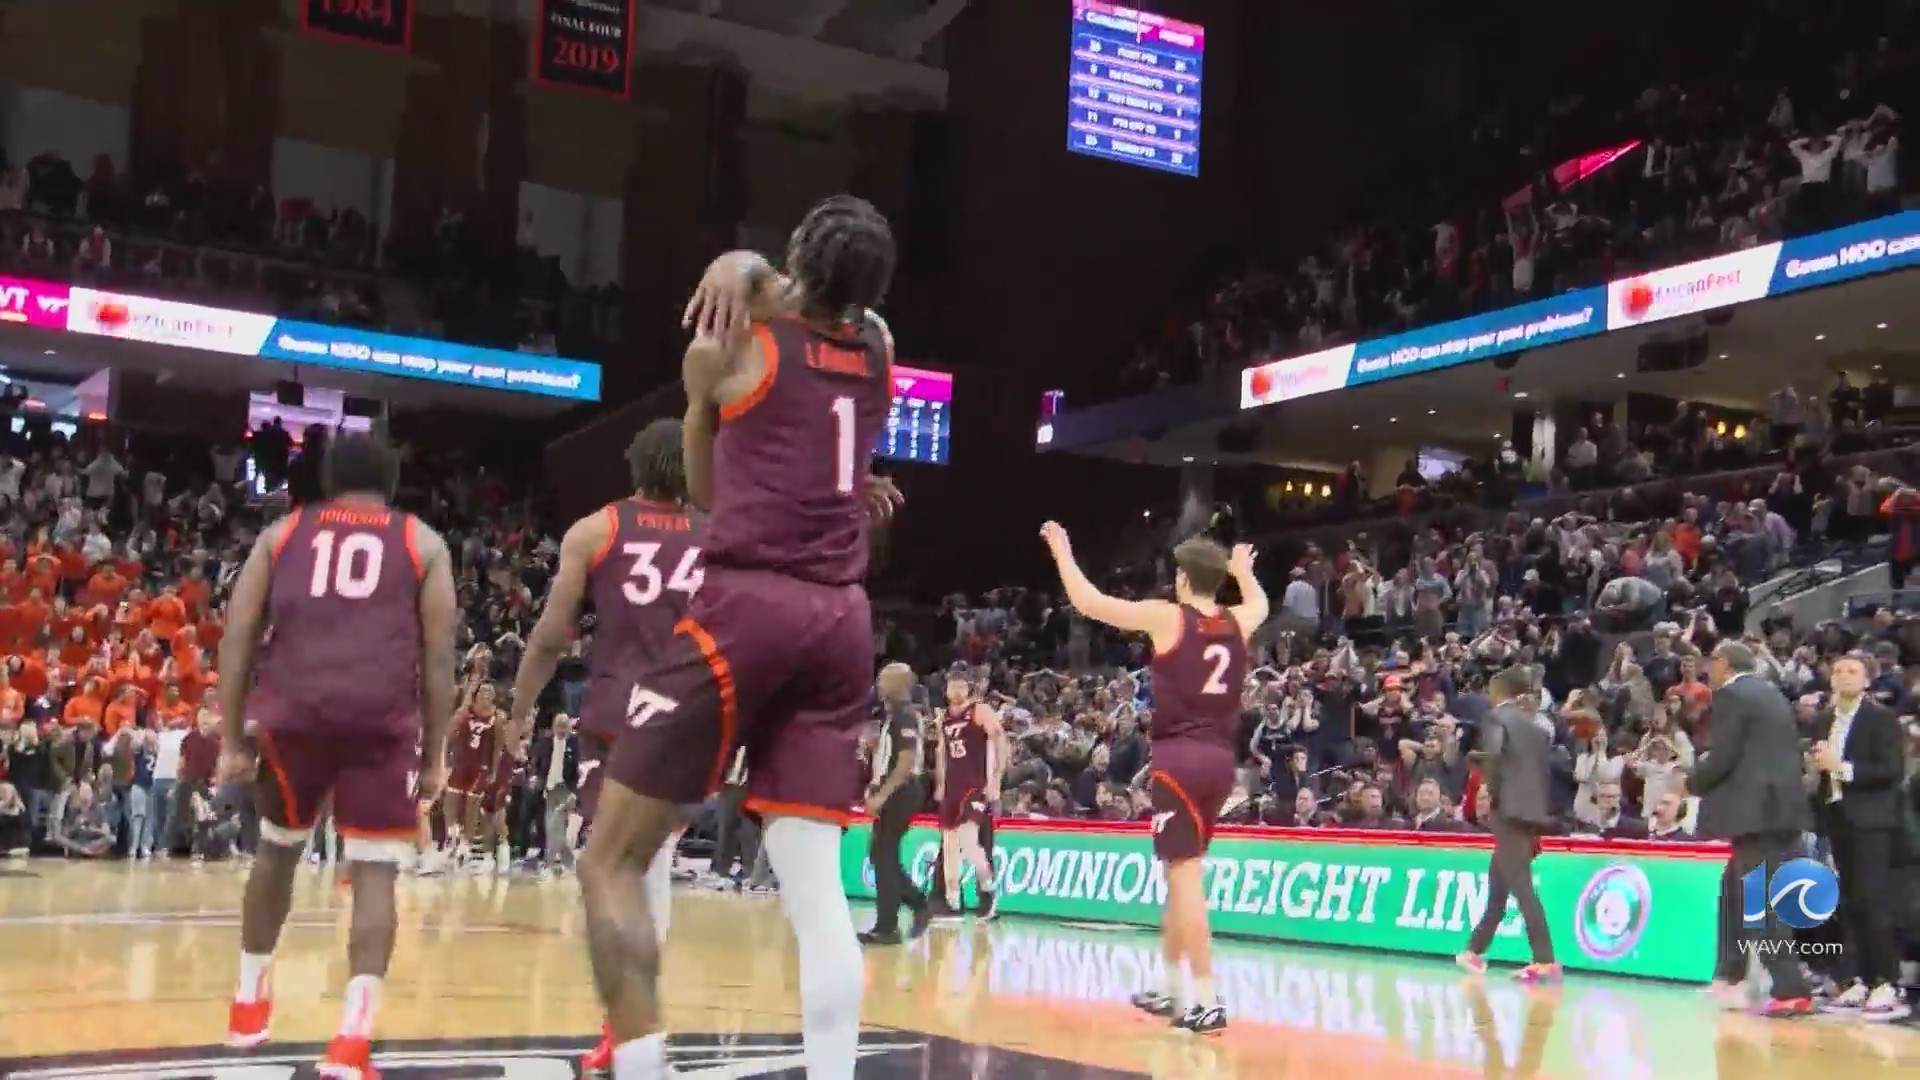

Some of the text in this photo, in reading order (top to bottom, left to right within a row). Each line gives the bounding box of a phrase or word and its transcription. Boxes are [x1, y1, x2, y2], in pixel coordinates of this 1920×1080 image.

[551, 11, 622, 38] FINAL FOUR
[552, 36, 620, 73] 2019
[830, 396, 855, 494] 1
[309, 529, 384, 599] 10
[622, 542, 706, 606] 34
[1201, 643, 1232, 695] 2
